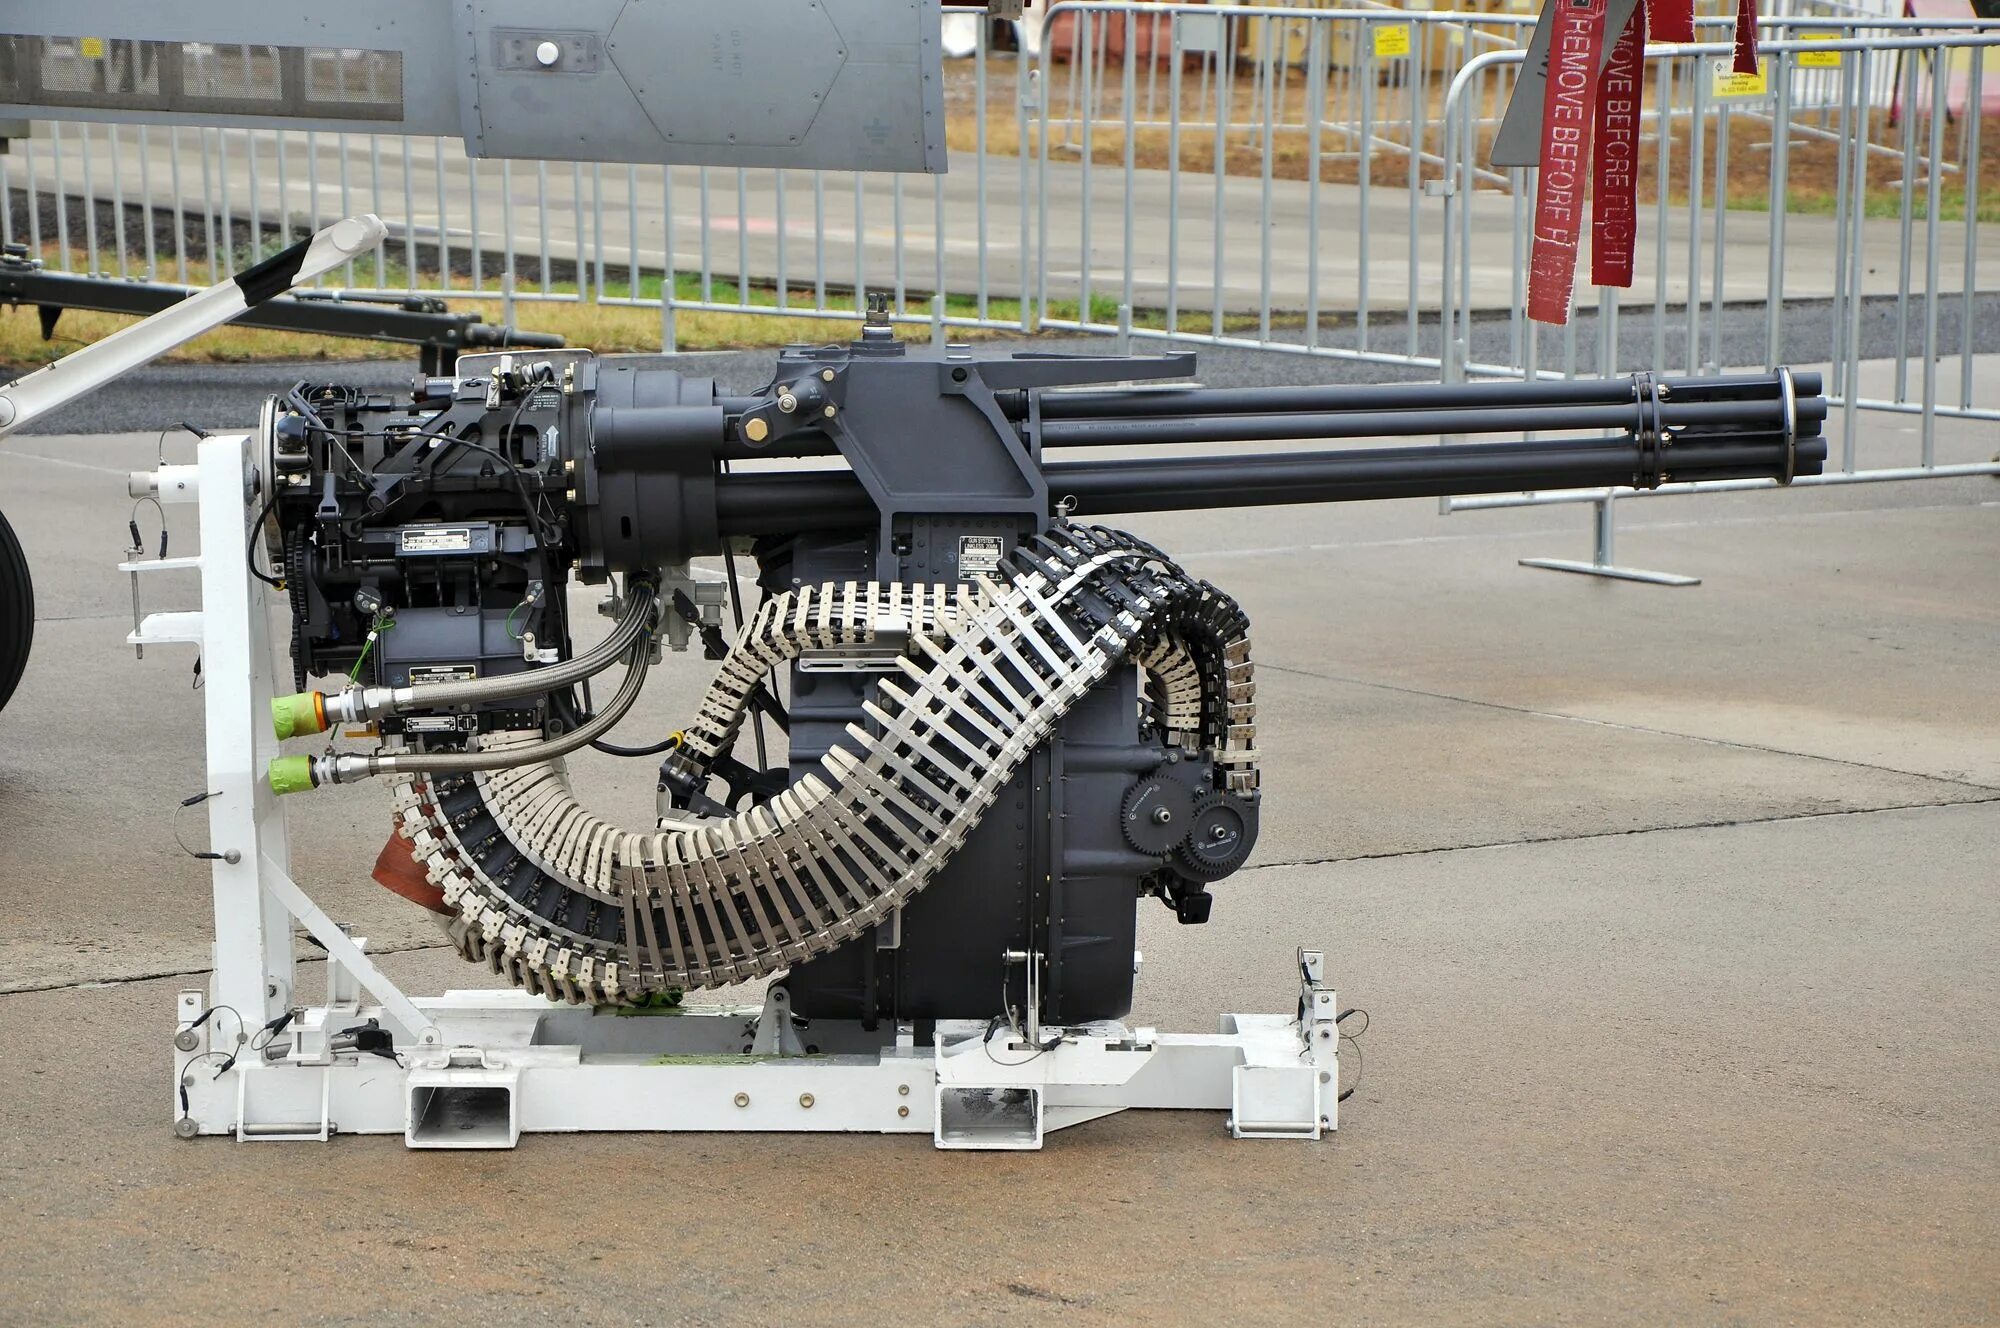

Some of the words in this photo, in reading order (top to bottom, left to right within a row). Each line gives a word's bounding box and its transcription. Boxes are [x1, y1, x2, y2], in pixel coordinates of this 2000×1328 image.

[1554, 19, 1592, 120] REMOVE
[1544, 126, 1580, 221] BEFORE
[1605, 100, 1632, 187] BEFORE
